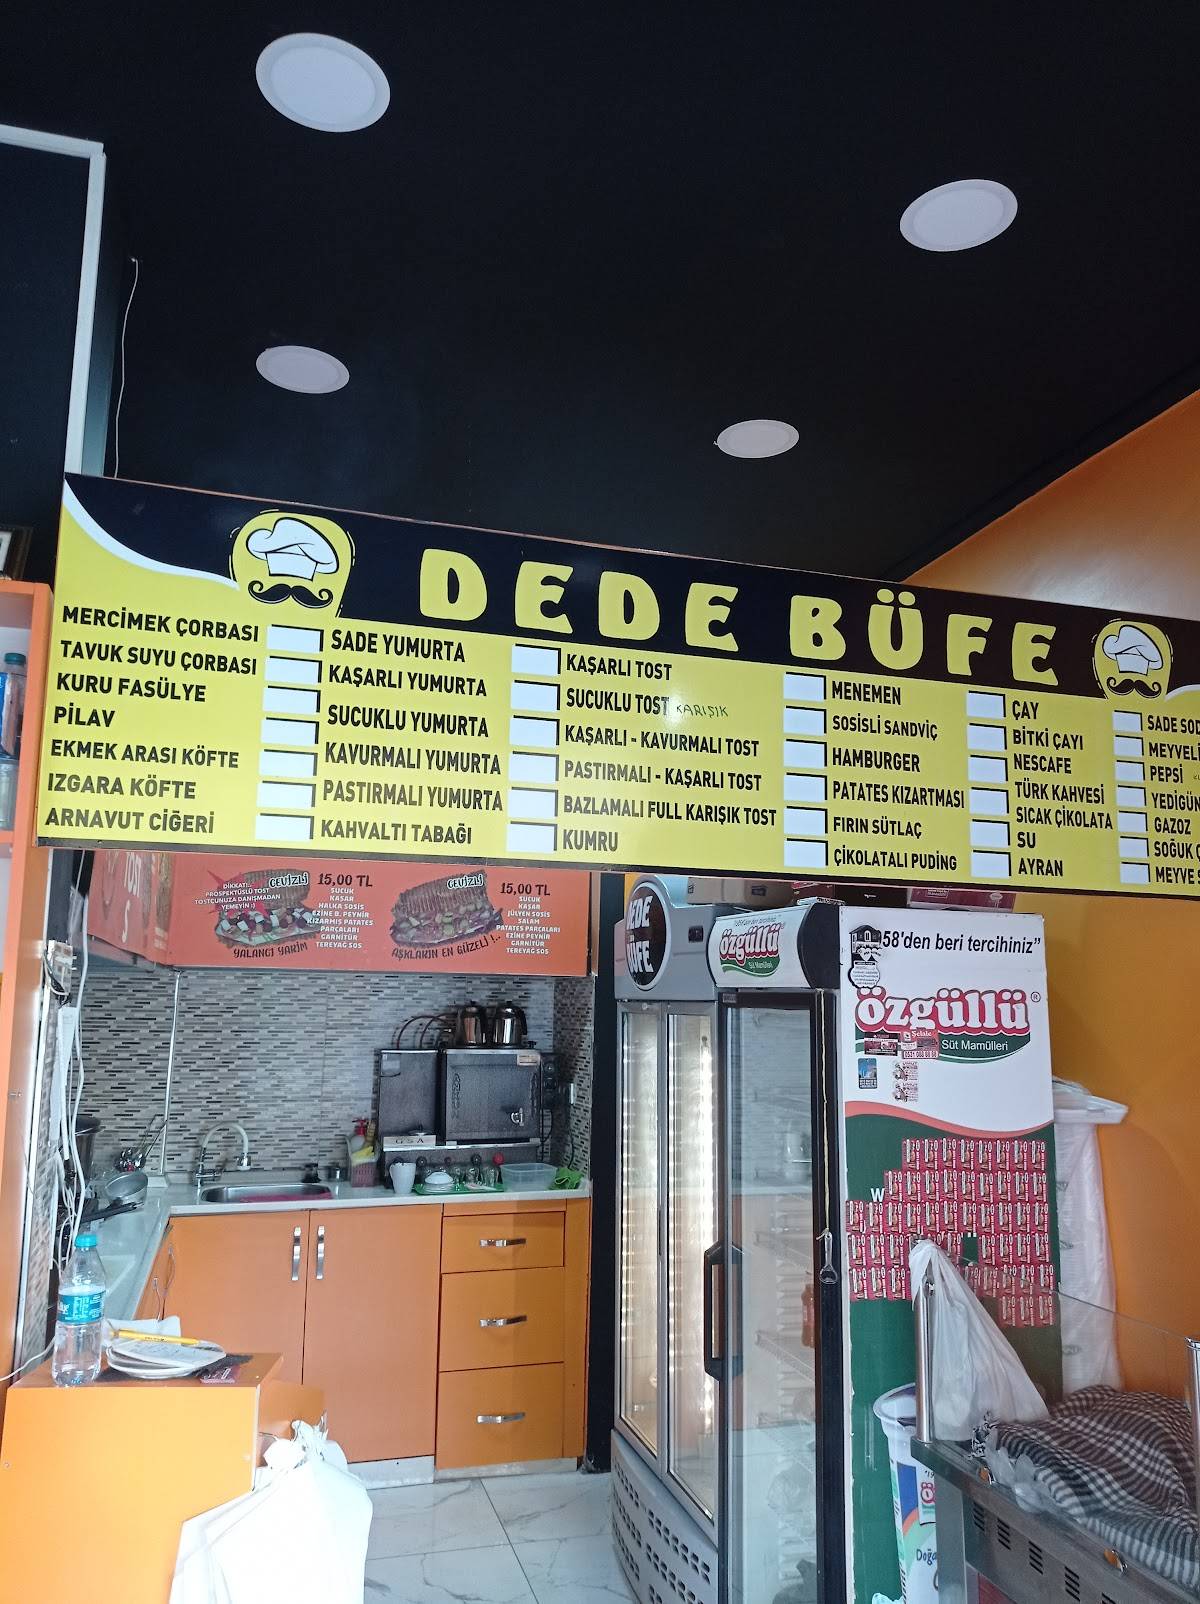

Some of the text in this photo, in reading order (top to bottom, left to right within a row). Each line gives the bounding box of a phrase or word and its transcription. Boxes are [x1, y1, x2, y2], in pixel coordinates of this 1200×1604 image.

[62, 605, 259, 642] MERCİMEK ÇORBASI
[419, 548, 1059, 686] DEDE BÜFE
[60, 640, 257, 675] TAVUK SUYU ÇORBASI
[331, 629, 465, 662] SADE YUMURTA
[566, 654, 672, 680] KAŞARLI TOST
[57, 673, 206, 702] KURU FASÜLYE
[329, 664, 487, 697] KAŞARLI YUMURTA
[832, 680, 901, 705] MENEMEN
[54, 702, 115, 728] PİLAV
[566, 688, 669, 716] SUCUKLU TOST
[676, 704, 729, 719] KARIŞIK
[1012, 700, 1039, 720] ÇAY
[328, 704, 489, 738] SUCUKLU YUMURTA
[832, 713, 938, 741] SOSİSLİ SANDVİÇ
[1147, 715, 1177, 733] SADE
[565, 725, 627, 746] KAŞARLI
[641, 731, 722, 754] KAVURMALI
[726, 738, 759, 757] TOST
[1013, 725, 1083, 751] BİTKİ ÇAYI
[51, 739, 239, 768] EKMEK ARASI KÖFTE
[325, 742, 501, 775] KAVURMALI YUMURTA
[832, 747, 920, 772] HAMBURGER
[1013, 753, 1072, 774] NESCAFE
[48, 773, 197, 799] IZGARA KÖFTE
[564, 760, 651, 783] PASTIRMALI
[665, 768, 724, 788] KAŞARLI
[728, 772, 762, 791] TOST
[1150, 763, 1183, 784] PEPSİ
[323, 780, 503, 811] PASTIRMALI YUMURTA
[833, 780, 965, 809] PATATES KIZARTMASI
[1015, 778, 1105, 805] TÜRK KAHVESİ
[45, 808, 214, 834] ARNAVUT CİĞERİ
[563, 796, 777, 826] BAZLAMALI FULL KARIŞIK TOST
[1016, 805, 1113, 830] SICAK ÇİKOLATA
[321, 819, 472, 844] KAHVALTI TABAĞI
[833, 816, 922, 839] FIRIN SÜTLAÇ
[1154, 817, 1191, 835] GAZOZ
[563, 829, 618, 852] KUMRU
[1017, 831, 1036, 849] SU
[1154, 839, 1194, 860] SOĞUK
[834, 844, 957, 871] ÇİKOLATALI PUDİNG
[1018, 857, 1063, 877] AYRAN
[318, 873, 373, 887] 15,00 TL
[1155, 866, 1194, 885] MEYVE
[500, 882, 551, 896] 15,00 TL
[442, 947, 454, 957] EN
[882, 930, 931, 950] 58'den
[935, 933, 964, 951] beri
[941, 1038, 1008, 1051] Süt Mamülleri
